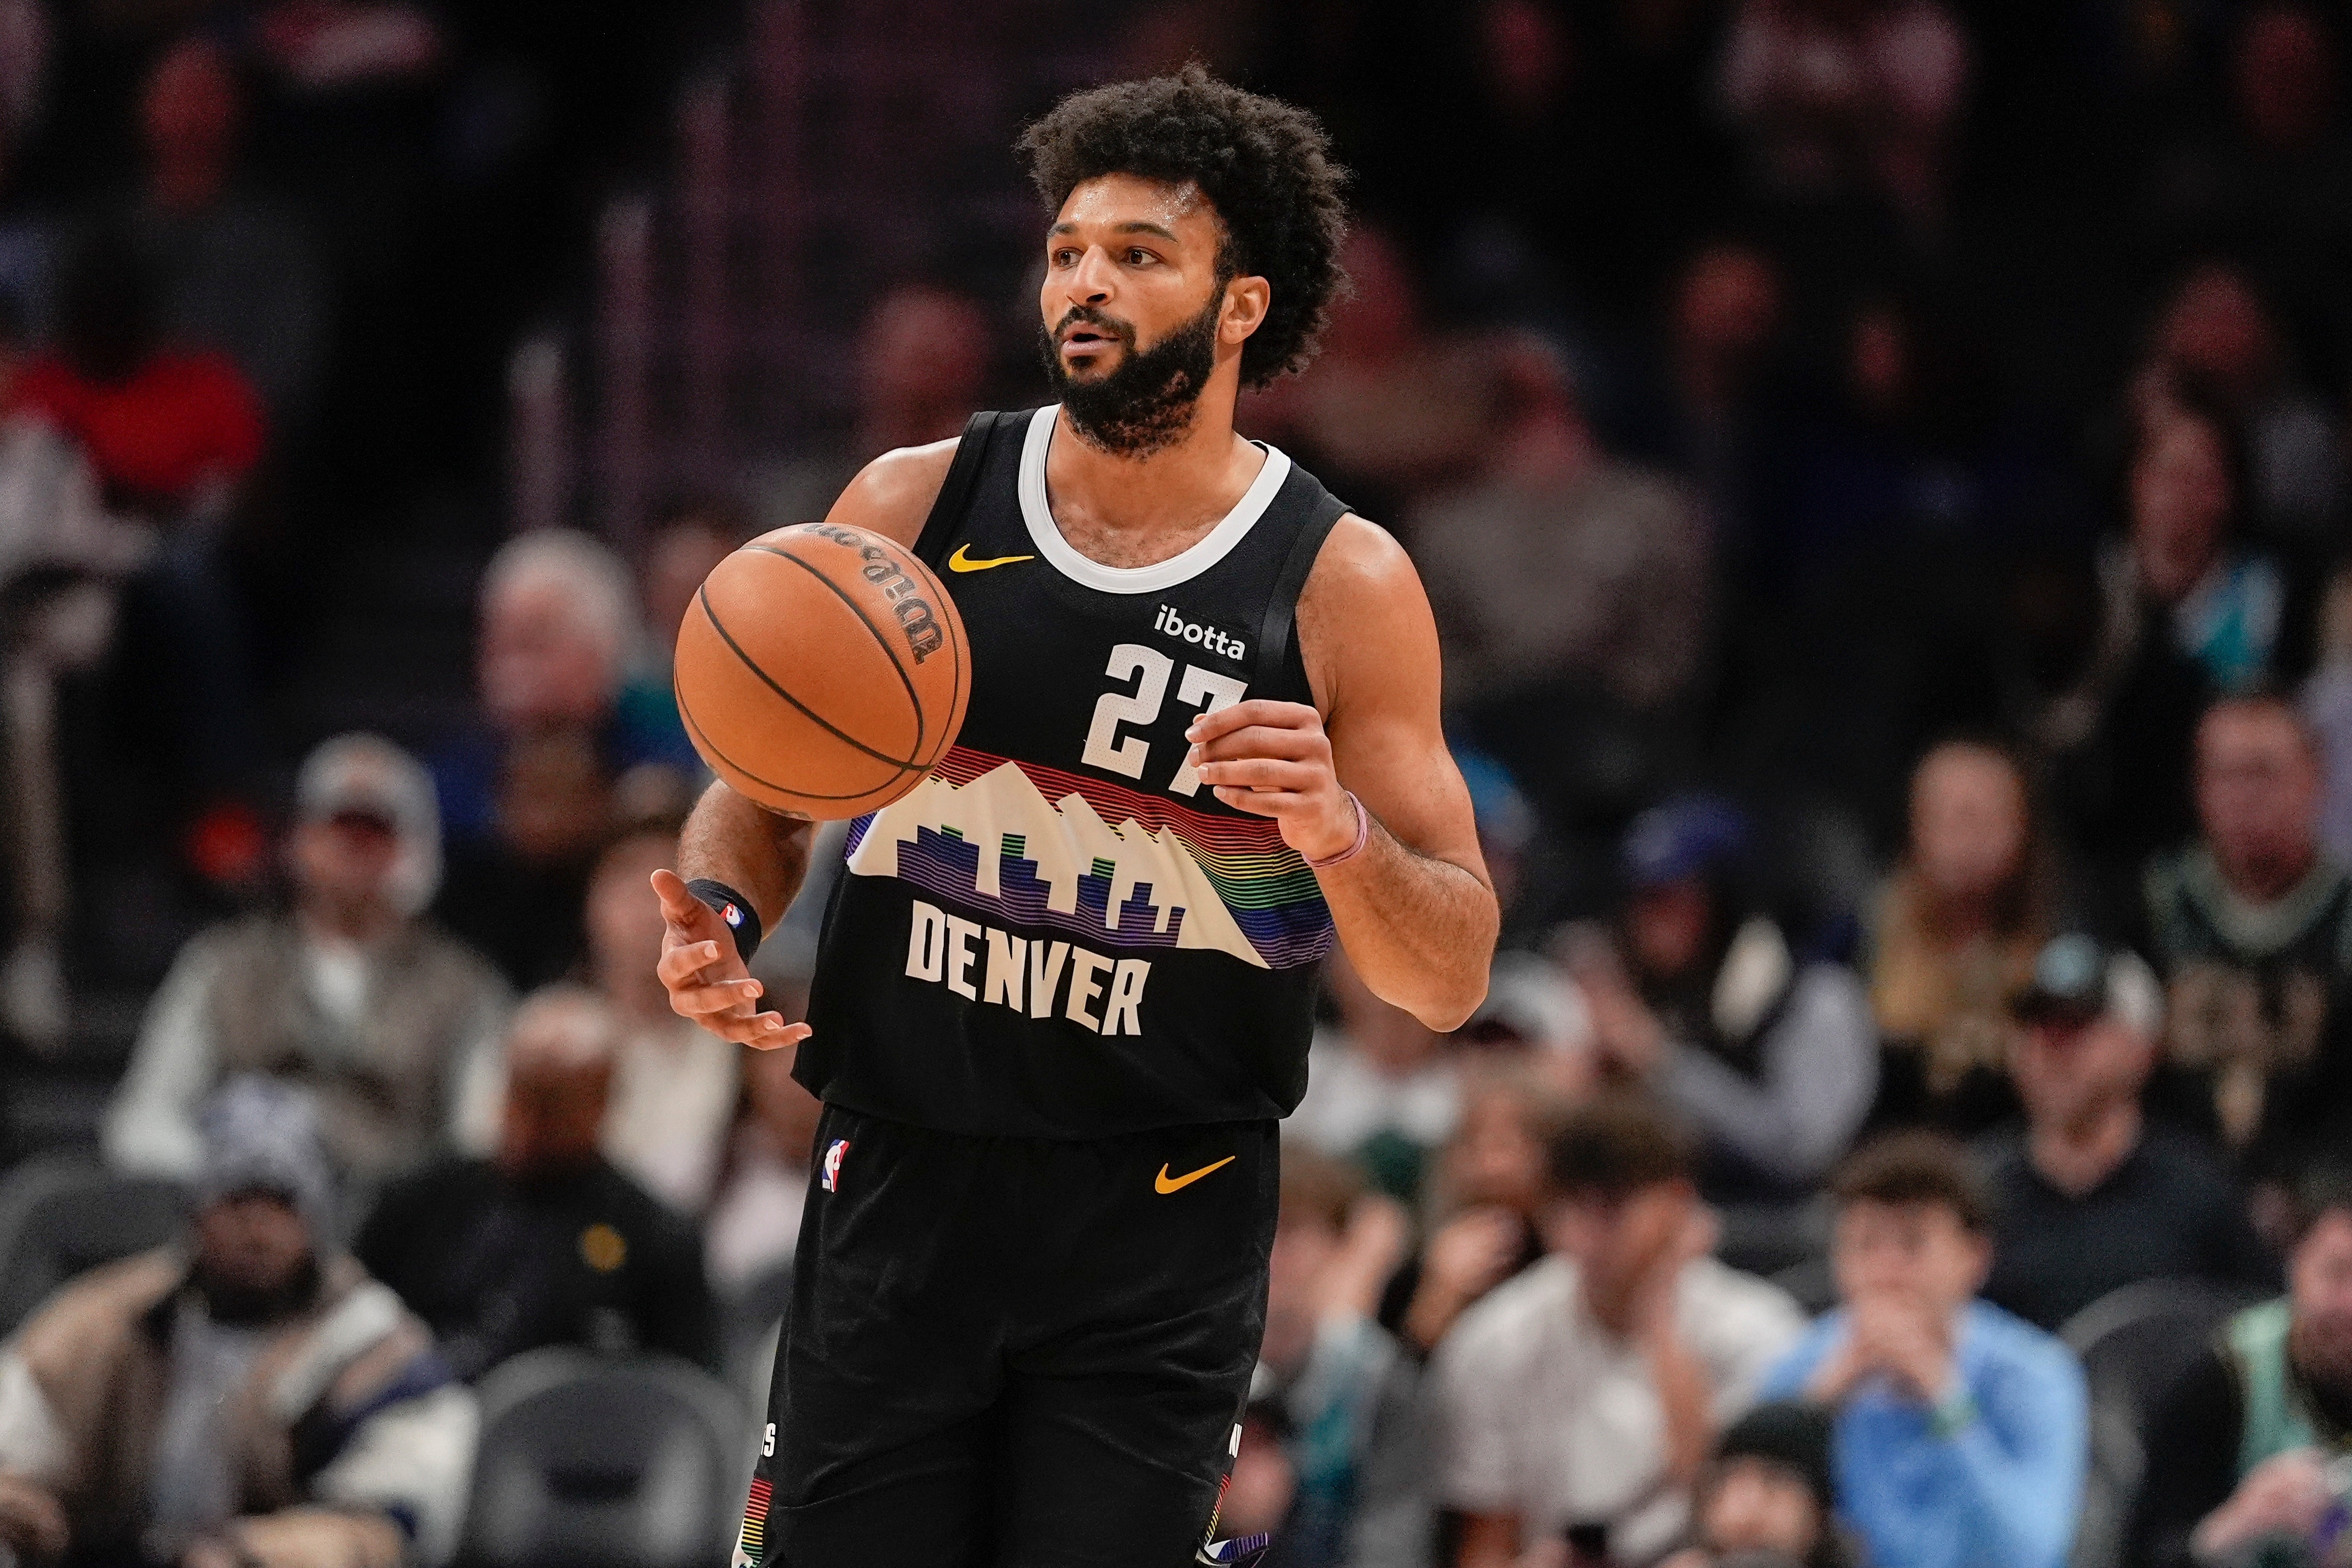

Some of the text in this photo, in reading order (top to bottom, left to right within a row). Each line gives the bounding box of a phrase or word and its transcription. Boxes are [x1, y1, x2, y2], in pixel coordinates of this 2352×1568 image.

[1154, 604, 1246, 660] ibotta
[1081, 644, 1248, 797] 27
[905, 899, 1152, 1036] DENVER
